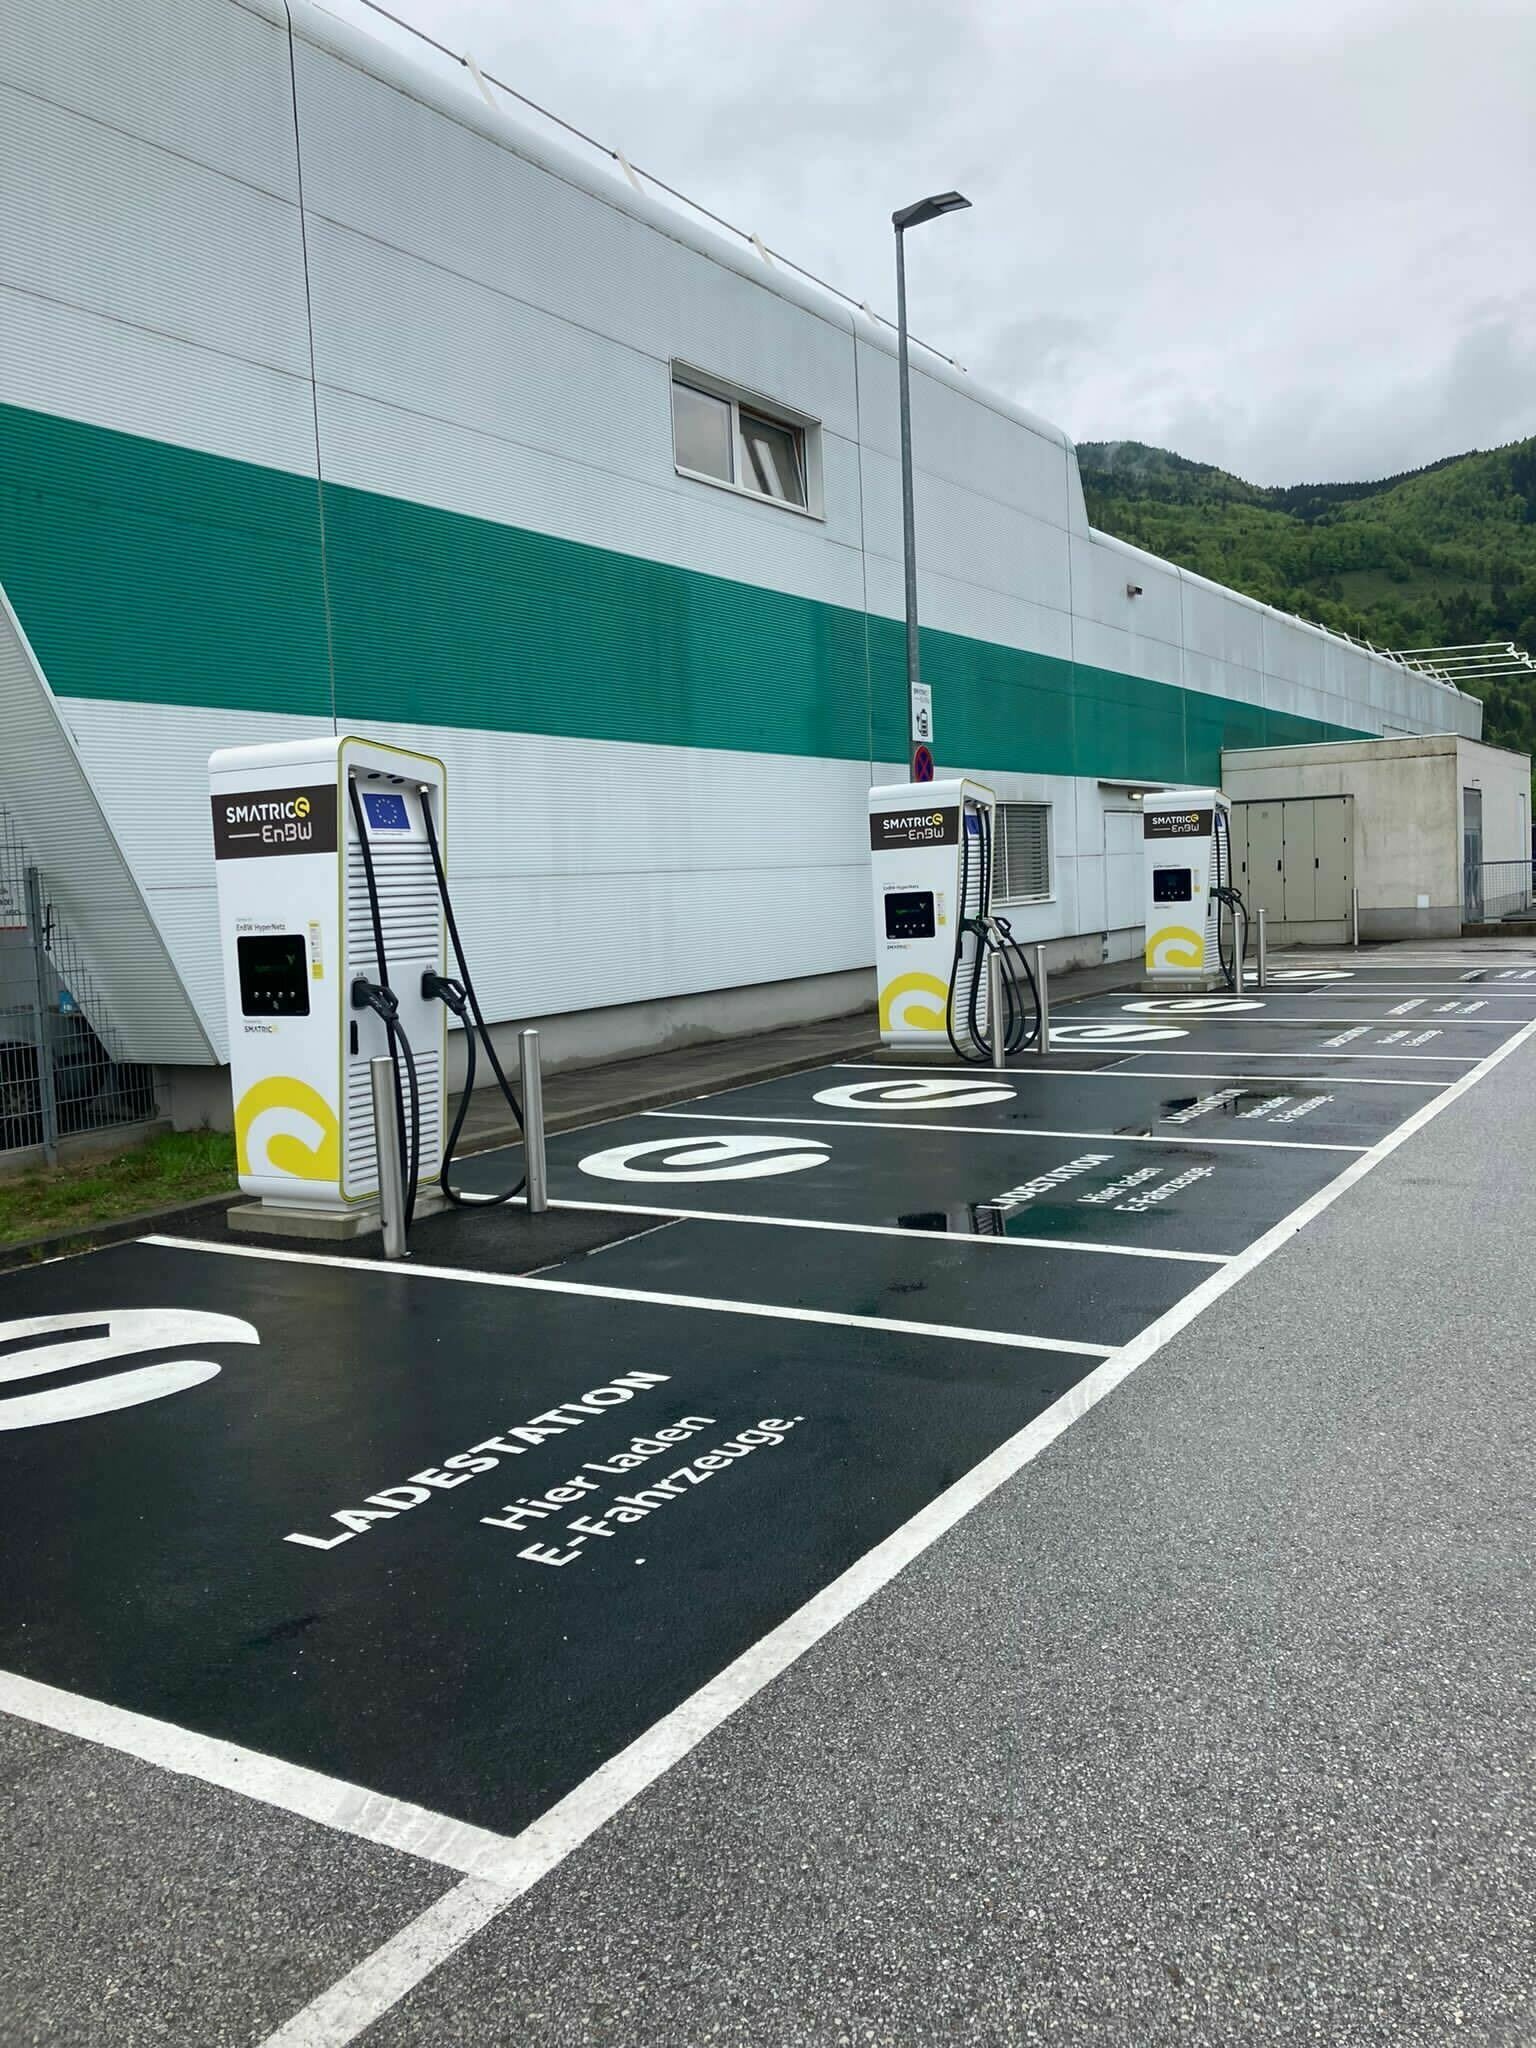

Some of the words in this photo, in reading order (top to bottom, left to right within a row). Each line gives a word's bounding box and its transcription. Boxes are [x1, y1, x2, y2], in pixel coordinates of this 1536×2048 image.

[262, 822, 312, 843] EnBW
[908, 827, 944, 841] EnBW
[976, 1153, 1115, 1210] LADESTATION
[283, 1370, 672, 1551] LADESTATION
[480, 1474, 602, 1531] Hier
[582, 1415, 717, 1474] laden
[516, 1414, 806, 1567] E-Fahrzeuge.
